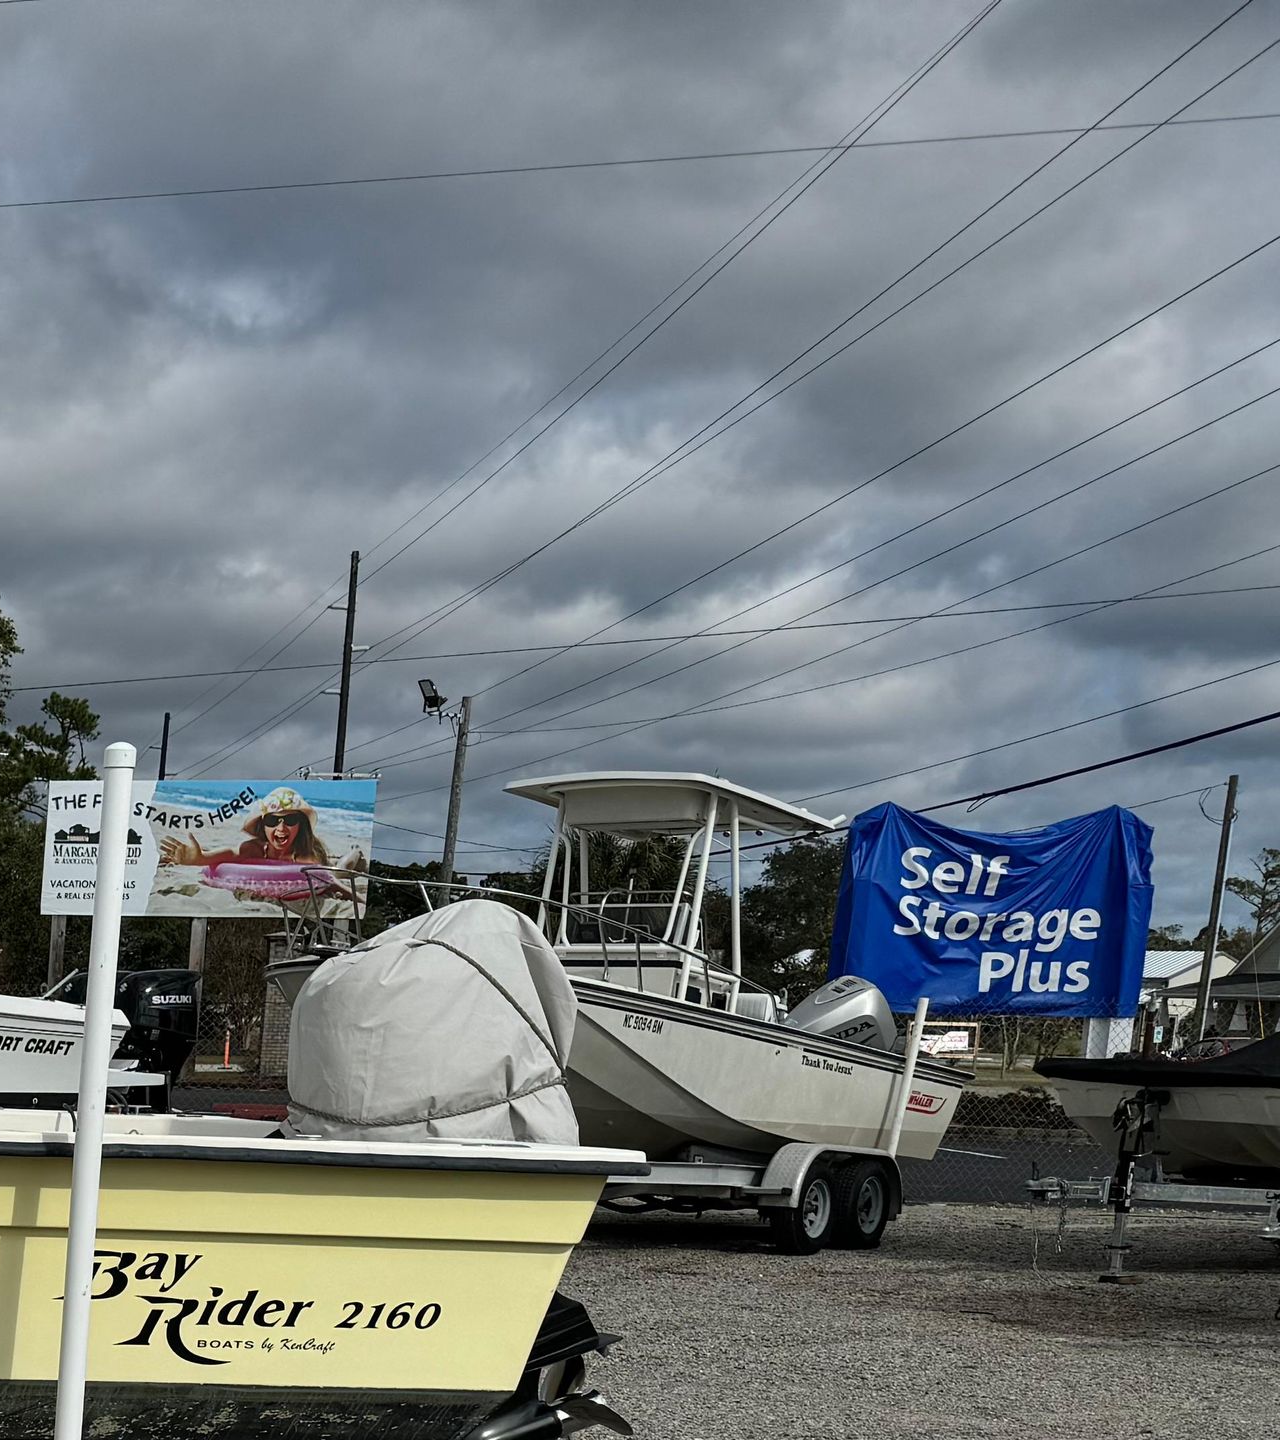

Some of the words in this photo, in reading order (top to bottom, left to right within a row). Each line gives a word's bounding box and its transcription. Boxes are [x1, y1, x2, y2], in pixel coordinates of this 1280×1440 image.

[52, 794, 87, 810] THE
[133, 801, 203, 829] STARTS
[208, 786, 258, 825] HERE!
[52, 845, 98, 858] MARGAR
[900, 847, 1010, 896] Self
[50, 880, 97, 889] VACATION
[893, 895, 1102, 952] Storage
[978, 949, 1090, 993] Plus
[152, 995, 192, 1005] SUZUKI
[831, 1021, 875, 1040] NDA
[24, 1038, 75, 1056] CRAFT
[801, 1055, 821, 1069] Thank
[824, 1059, 836, 1072] You
[836, 1062, 855, 1076] Jesus!
[53, 1249, 203, 1300] Bay
[113, 1286, 314, 1366] Rider
[334, 1301, 442, 1330] 2160
[196, 1339, 255, 1350] BOATS
[260, 1338, 274, 1352] by
[279, 1337, 336, 1355] KenCraft
